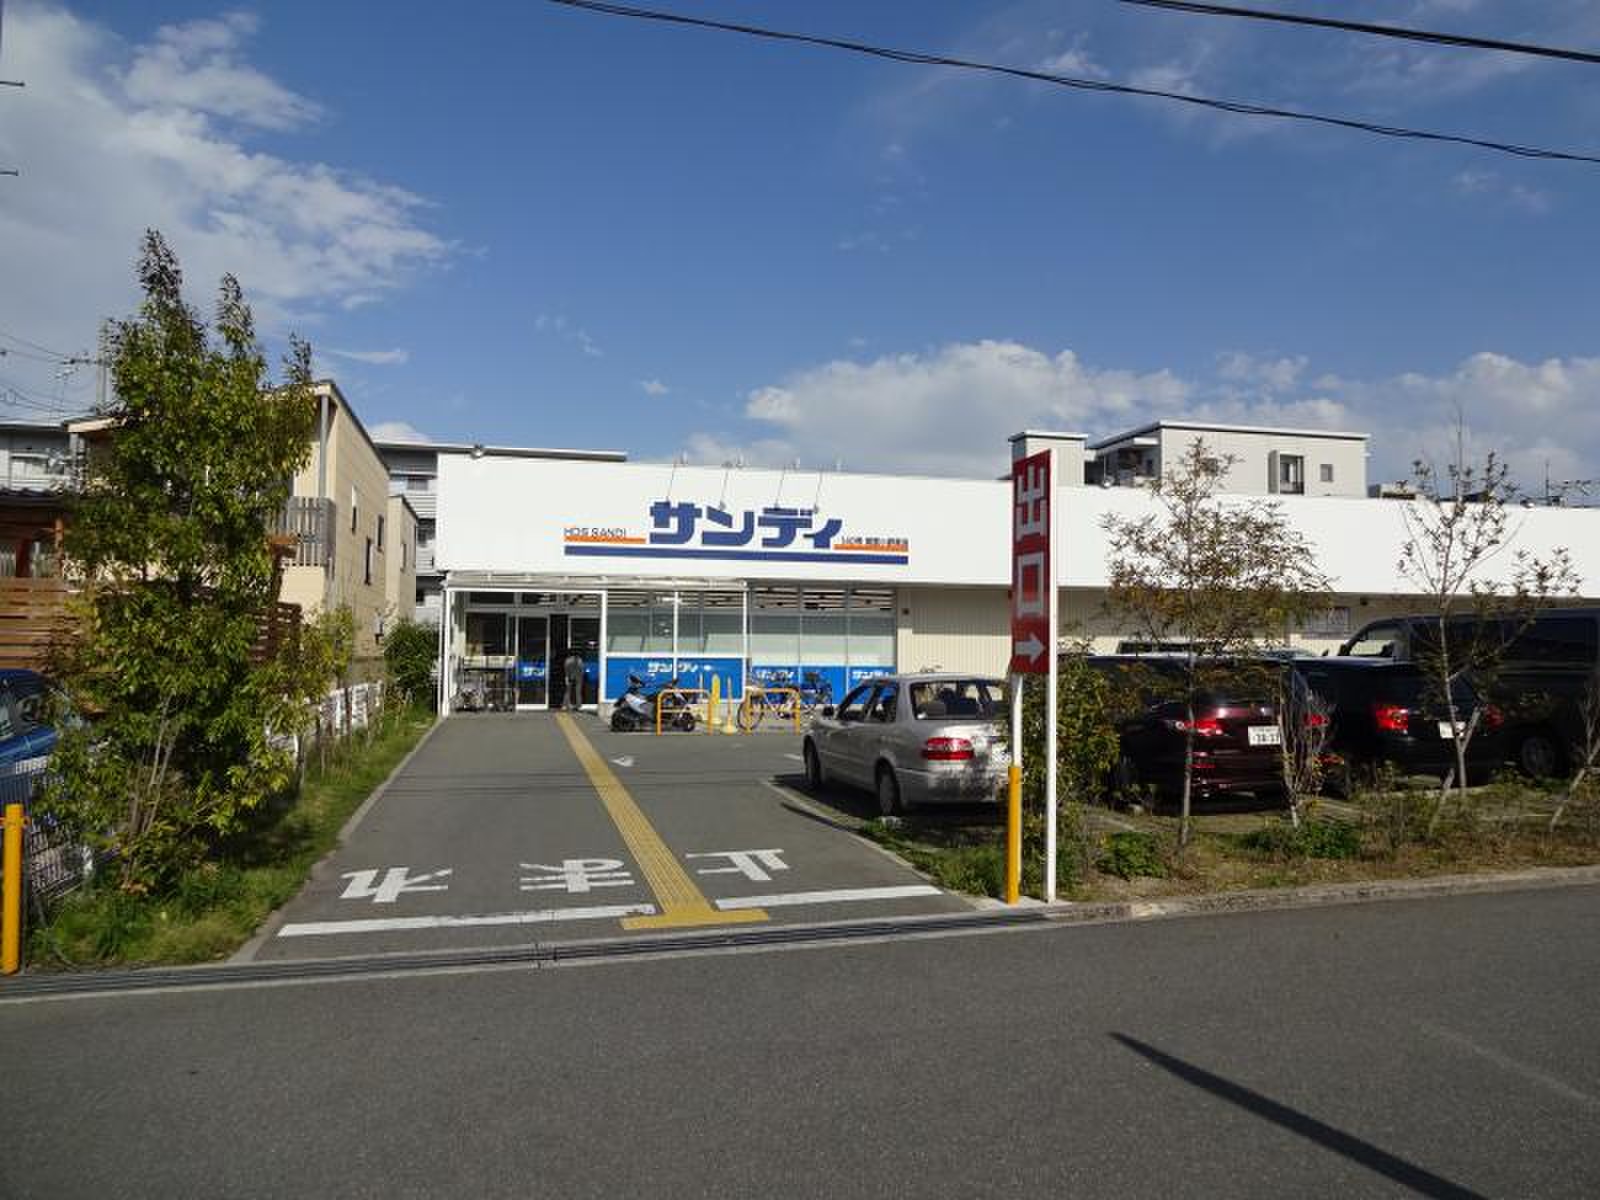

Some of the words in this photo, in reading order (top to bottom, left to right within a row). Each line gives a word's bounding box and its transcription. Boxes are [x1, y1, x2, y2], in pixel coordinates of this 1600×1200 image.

[648, 501, 843, 549] サンディ
[1016, 464, 1047, 619] 出口
